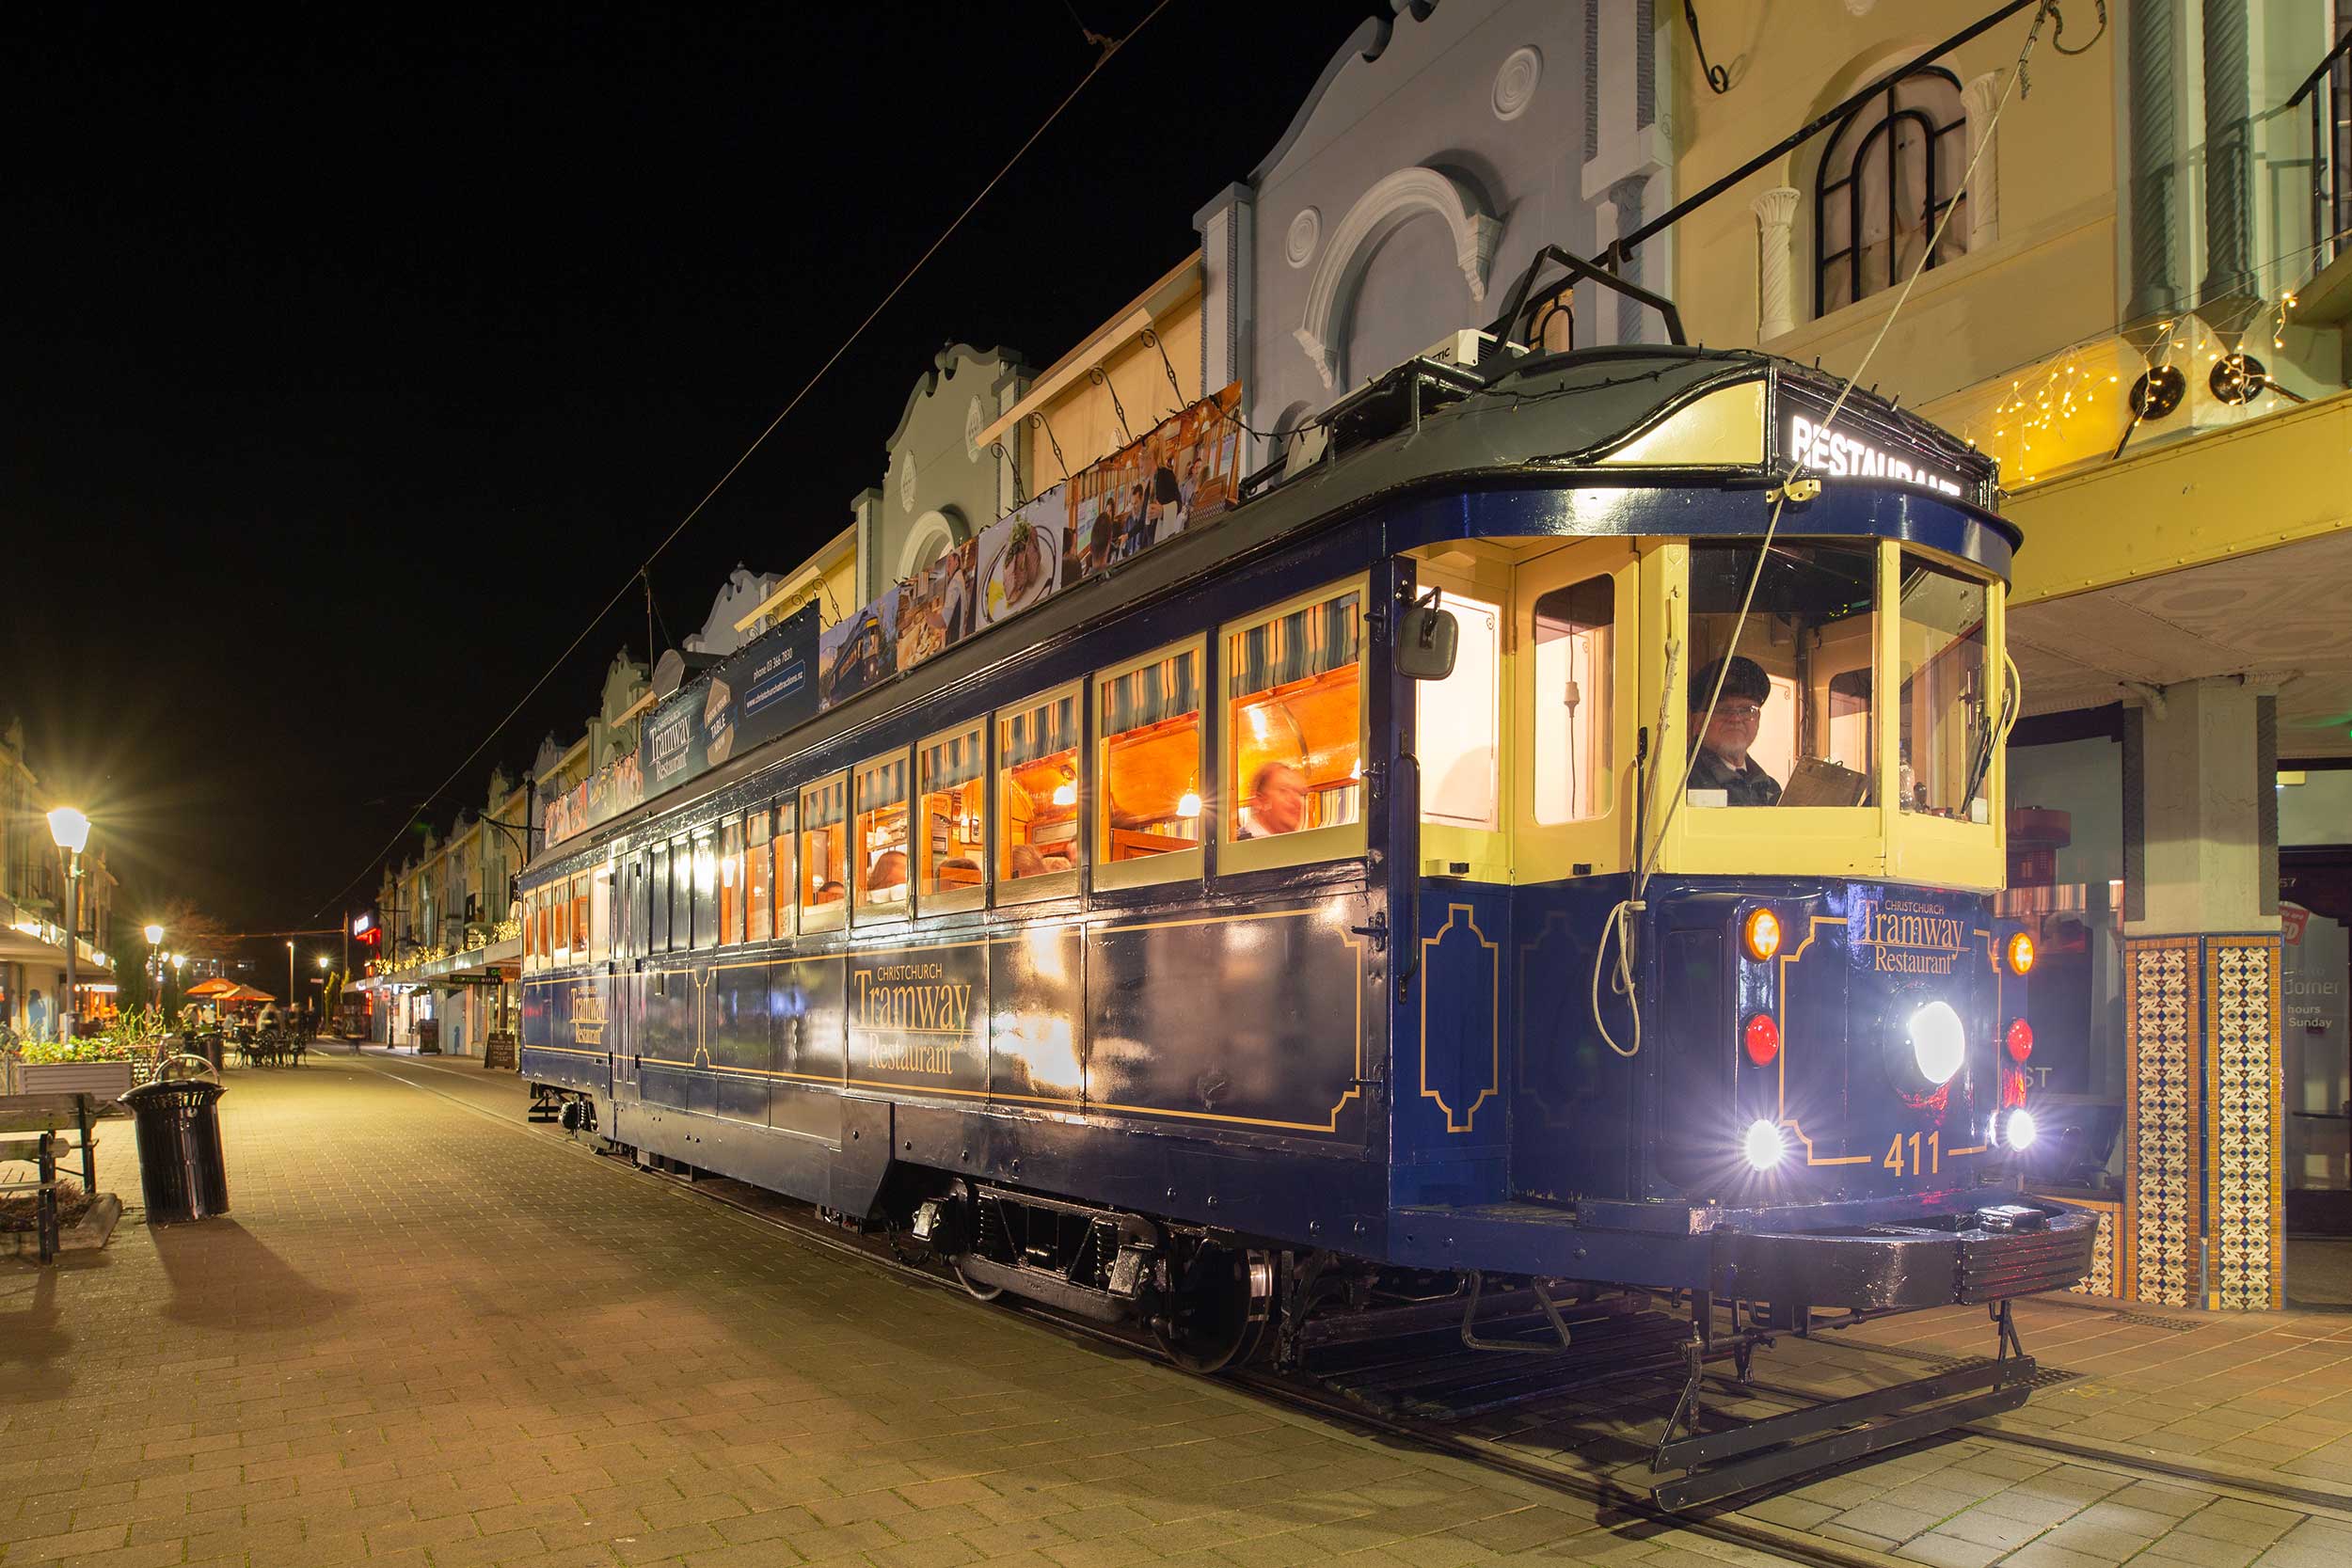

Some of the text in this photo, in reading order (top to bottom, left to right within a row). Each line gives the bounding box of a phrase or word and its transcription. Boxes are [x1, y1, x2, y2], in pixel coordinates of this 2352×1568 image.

[649, 714, 691, 763] Tramway
[710, 713, 725, 739] TABLE
[656, 751, 688, 783] Restaurant
[1884, 899, 1945, 915] CHRISTCHURCH
[1858, 899, 1964, 960] Tramway
[877, 962, 943, 981] CHRISTCHURCH
[1874, 944, 1952, 974] Restaurant
[571, 988, 607, 1033] Tramway
[854, 970, 972, 1051] Tramway
[2287, 1004, 2321, 1014] hours
[2288, 1017, 2332, 1029] Sunday
[867, 1033, 953, 1075] Restaurant
[1883, 1130, 1939, 1177] 411
